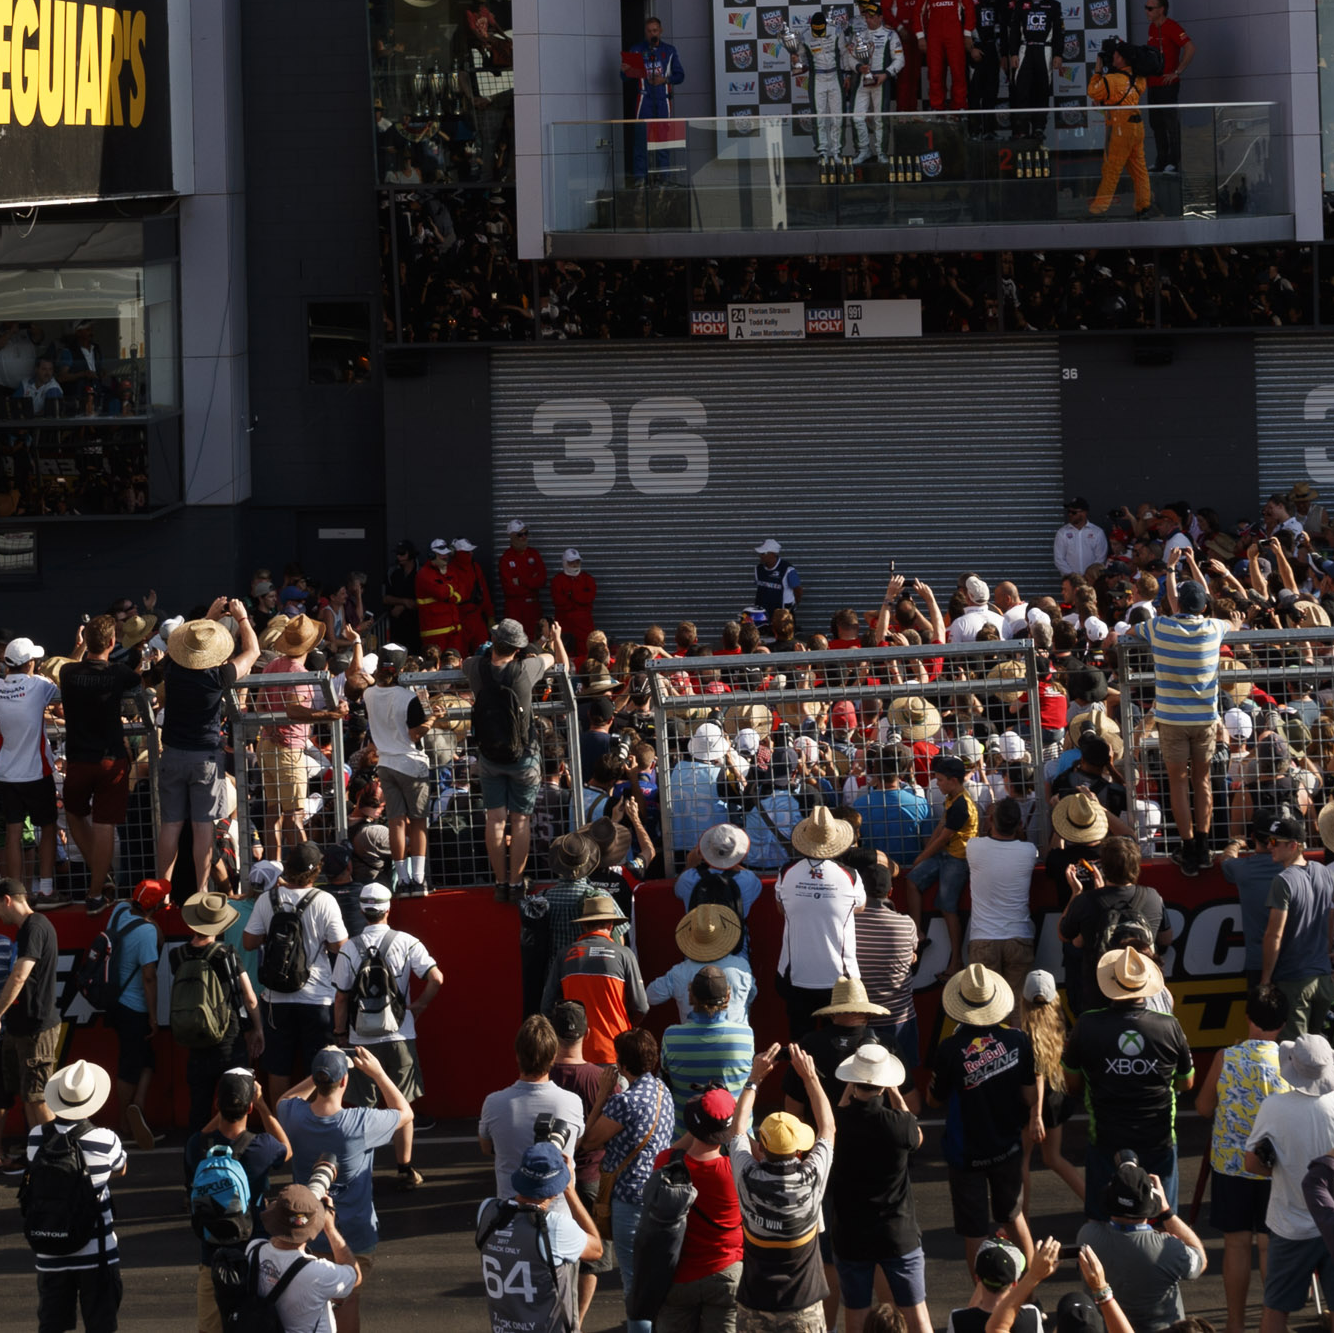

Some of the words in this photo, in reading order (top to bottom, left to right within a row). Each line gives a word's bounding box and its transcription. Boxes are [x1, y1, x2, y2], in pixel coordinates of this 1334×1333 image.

[1028, 15, 1047, 25] ICE
[729, 82, 755, 92] NSW
[924, 130, 934, 150] 1
[999, 149, 1013, 171] 2
[692, 311, 726, 323] LIQUI
[732, 309, 745, 322] 24
[807, 309, 841, 321] LIQUI
[847, 305, 861, 319] 991
[692, 322, 727, 335] MOLY
[735, 326, 744, 339] A
[808, 320, 843, 332] MOLY
[851, 323, 860, 336] A
[1062, 368, 1078, 380] 36
[532, 396, 710, 496] 36
[964, 1053, 986, 1074] Red
[983, 1041, 1008, 1062] Bull
[963, 1047, 1020, 1087] RACING
[1105, 1058, 1159, 1075] XBOX
[766, 1218, 783, 1230] WIN
[486, 1243, 503, 1252] TRACK
[504, 1246, 521, 1254] ONLY
[482, 1254, 538, 1303] 64
[512, 1319, 536, 1331] ONLY
